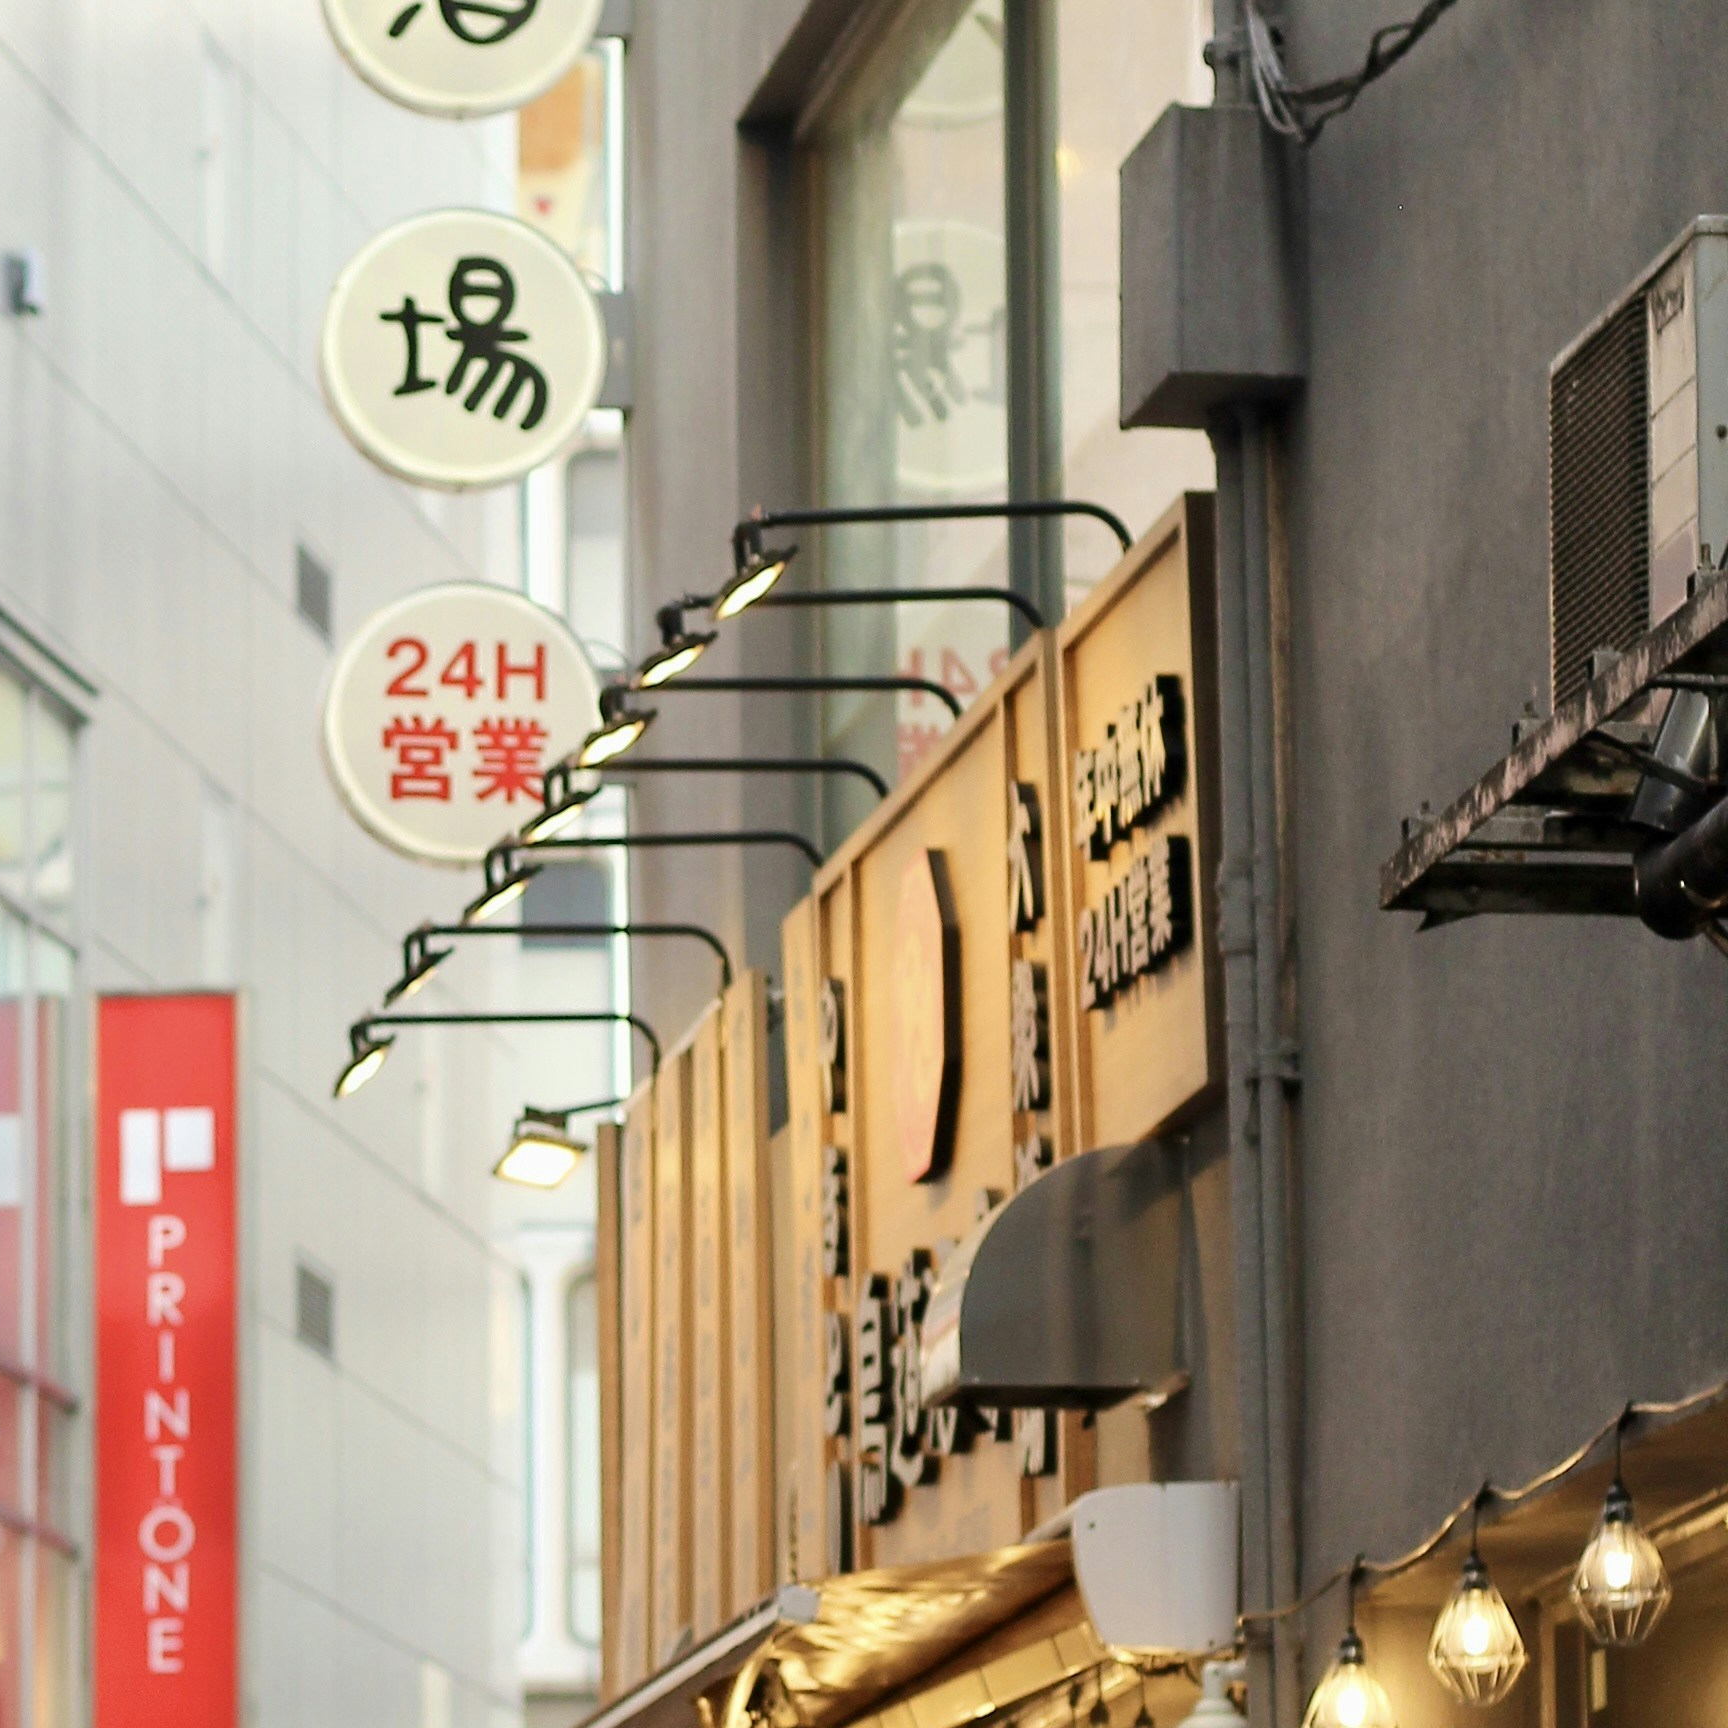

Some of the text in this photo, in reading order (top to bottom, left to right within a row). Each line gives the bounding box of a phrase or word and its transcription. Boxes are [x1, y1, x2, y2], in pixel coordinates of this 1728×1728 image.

[384, 638, 548, 702] 24H
[382, 715, 549, 805] 営業
[1078, 838, 1174, 1010] 24H営業
[139, 1215, 196, 1674] PRINTONE
